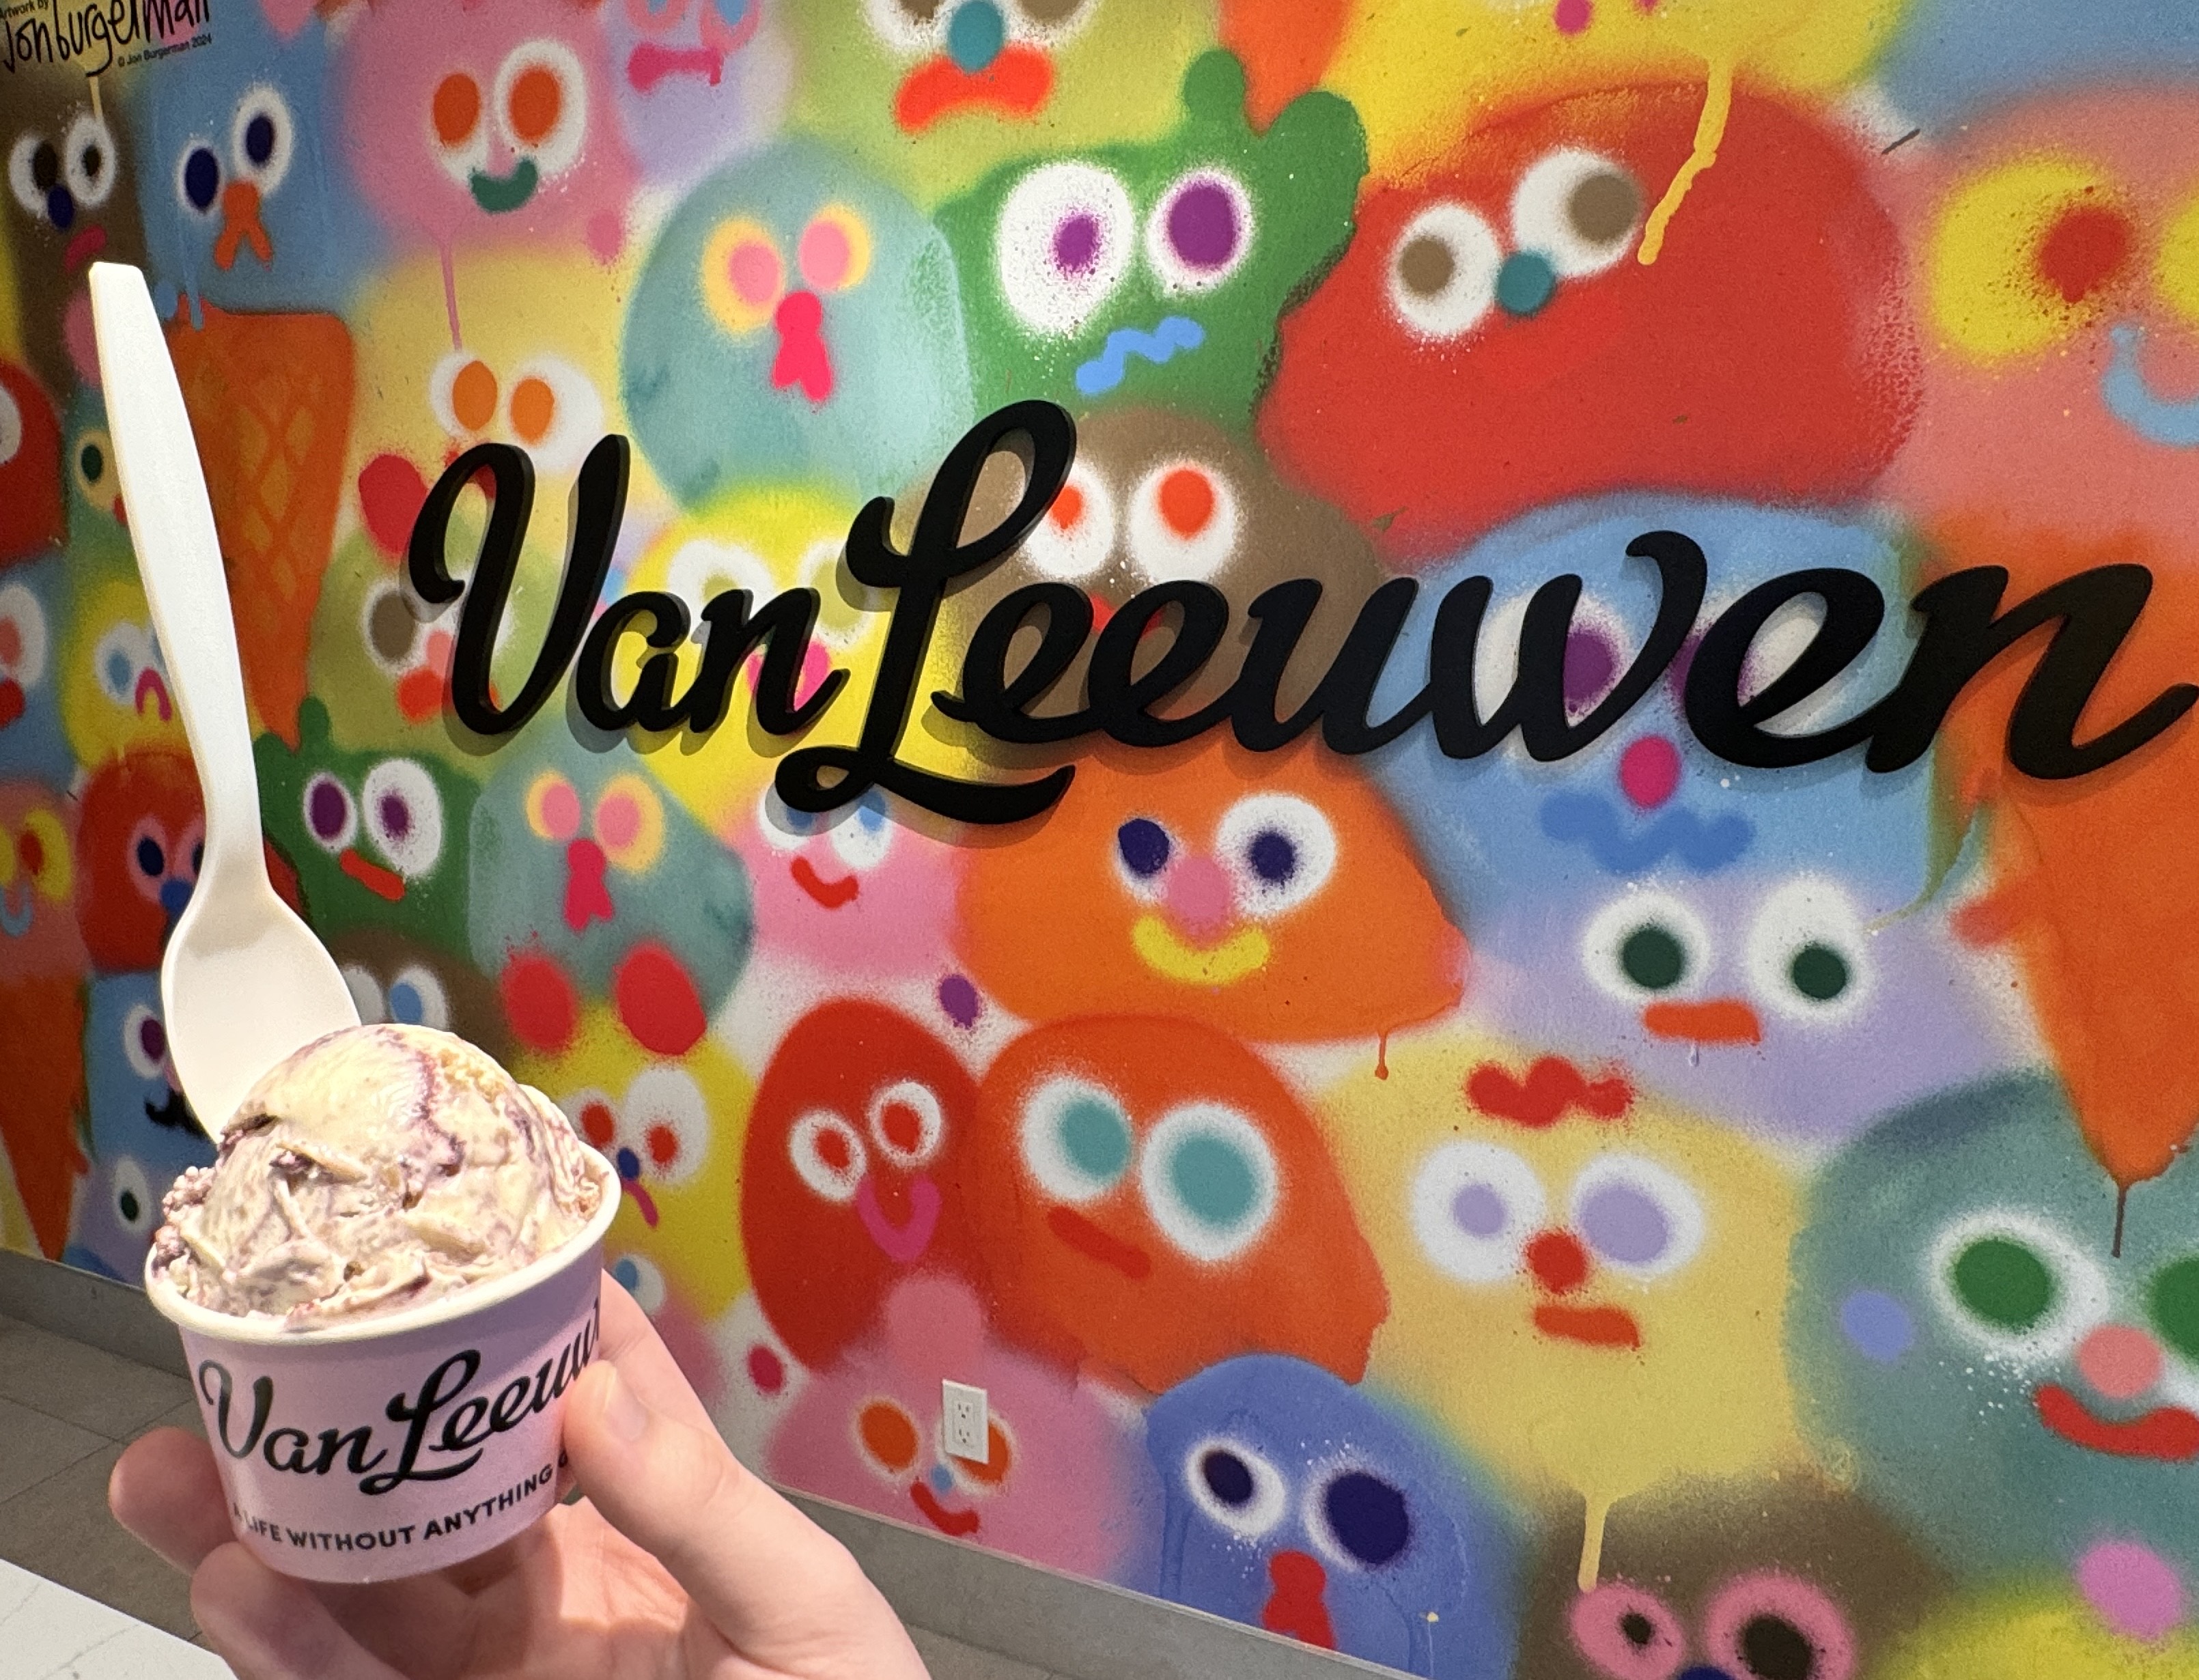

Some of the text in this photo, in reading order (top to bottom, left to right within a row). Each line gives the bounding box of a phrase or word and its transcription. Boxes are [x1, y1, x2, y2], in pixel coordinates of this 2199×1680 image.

[127, 54, 142, 65] Jon
[408, 399, 2199, 825] Van Leeuwen
[199, 1296, 600, 1496] Van Leeuw
[244, 1510, 282, 1542] LIFE
[285, 1525, 416, 1550] WITHOUT
[423, 1463, 554, 1541] ANYTHING
